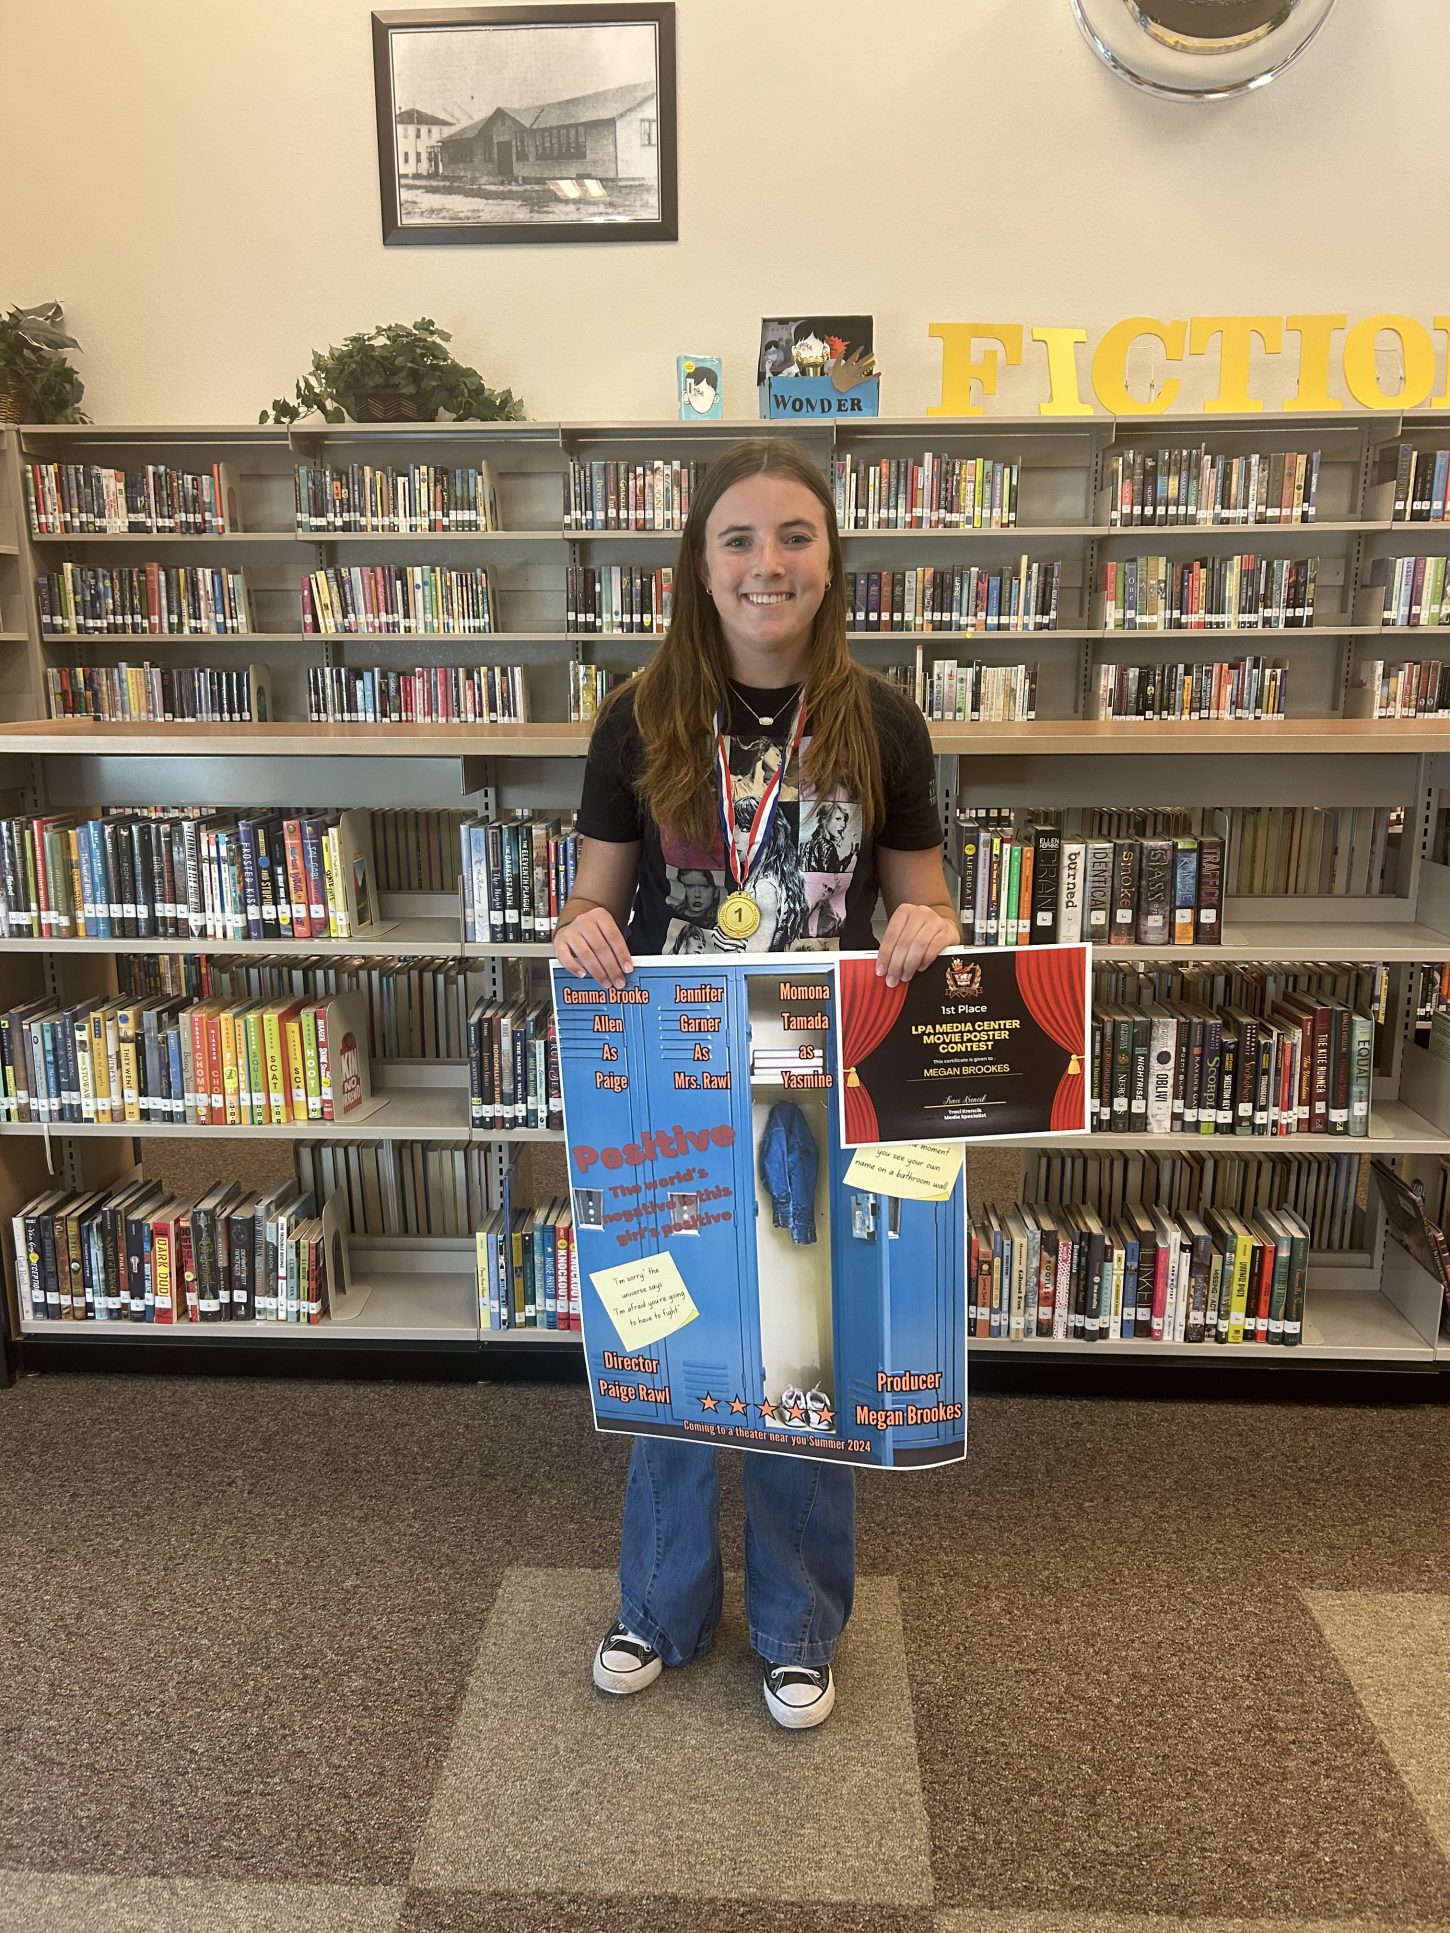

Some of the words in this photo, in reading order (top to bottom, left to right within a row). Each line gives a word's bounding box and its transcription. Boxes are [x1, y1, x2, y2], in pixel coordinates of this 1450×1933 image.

[926, 313, 1450, 416] FICTIO
[772, 393, 863, 414] WONDER
[241, 842, 254, 883] FROSTED
[504, 855, 513, 887] DARKEST
[521, 849, 529, 885] ELEVENTH
[7, 875, 15, 896] flood
[965, 856, 973, 900] LIFEBOAT
[1065, 851, 1081, 909] burned
[1119, 851, 1135, 908] Smoke
[154, 878, 164, 903] STOLE
[522, 885, 530, 912] PLAGUE
[734, 908, 743, 923] 1
[563, 987, 606, 1004] Gemma
[608, 987, 649, 1004] Brooke
[675, 985, 723, 1003] Jennifer
[779, 982, 830, 1000] Momona
[941, 1005, 956, 1015] 1st
[958, 1003, 988, 1014] Place
[593, 1015, 623, 1032] Allen
[680, 1017, 721, 1033] Garner
[781, 1012, 829, 1030] Tamada
[911, 1024, 935, 1036] LPA
[935, 1022, 973, 1033] MEDIA
[974, 1019, 1021, 1031] CENTER
[923, 1033, 963, 1044] MOVIE
[964, 1031, 1009, 1042] POSTER
[939, 1041, 994, 1053] CONTEST
[1318, 1034, 1328, 1047] THE
[603, 1043, 618, 1061] As
[693, 1043, 710, 1061] As
[799, 1045, 814, 1060] as
[1317, 1049, 1328, 1064] KITE
[1356, 1040, 1369, 1082] EQUAL
[124, 1068, 132, 1089] WENT
[195, 1053, 205, 1093] CHOMP
[270, 1055, 279, 1090] SCAT
[294, 1068, 302, 1089] SCA
[307, 1049, 316, 1088] HOOT
[924, 1067, 960, 1077] MEGAN
[962, 1064, 1010, 1075] BROOKES
[1135, 1056, 1145, 1100] NIGHTRISE
[80, 1066, 92, 1099] STOWAW
[344, 1077, 357, 1093] NO
[595, 1072, 628, 1092] Paige
[674, 1073, 700, 1090] Mrs.
[702, 1072, 732, 1090] Rawl
[781, 1070, 833, 1089] Yasmine
[1242, 1061, 1256, 1103] Snakehea
[1316, 1067, 1327, 1093] RUNNER
[572, 1124, 736, 1174] Positive
[921, 1144, 951, 1156] moment
[874, 1149, 890, 1158] you
[893, 1153, 905, 1161] see
[905, 1158, 924, 1168] your
[926, 1164, 941, 1172] own
[609, 1183, 642, 1199] The
[644, 1167, 709, 1191] world's
[855, 1160, 876, 1170] name
[896, 1169, 931, 1186] bathroom
[932, 1182, 949, 1190] wall
[602, 1197, 676, 1224] negative
[696, 1185, 733, 1202] this
[616, 1226, 660, 1247] girl's
[156, 1238, 168, 1268] DARK
[648, 1267, 659, 1275] the
[158, 1272, 169, 1296] DUD
[622, 1288, 647, 1299] universe
[648, 1282, 663, 1292] says
[628, 1300, 646, 1312] afraid
[648, 1295, 666, 1309] you're
[669, 1291, 686, 1303] going
[630, 1319, 637, 1327] to
[638, 1316, 653, 1324] have
[603, 1350, 659, 1374] Director
[877, 1370, 942, 1392] Producer
[598, 1379, 636, 1402] Paige
[637, 1383, 671, 1405] Rawl
[856, 1404, 904, 1431] Megan
[906, 1401, 962, 1426] Brookes
[683, 1420, 715, 1436] Coming
[716, 1424, 726, 1435] to
[728, 1427, 734, 1436] a
[735, 1427, 767, 1441] theater
[769, 1433, 789, 1443] near
[791, 1436, 808, 1447] you
[808, 1436, 845, 1450] Summer
[848, 1439, 871, 1454] 2024
